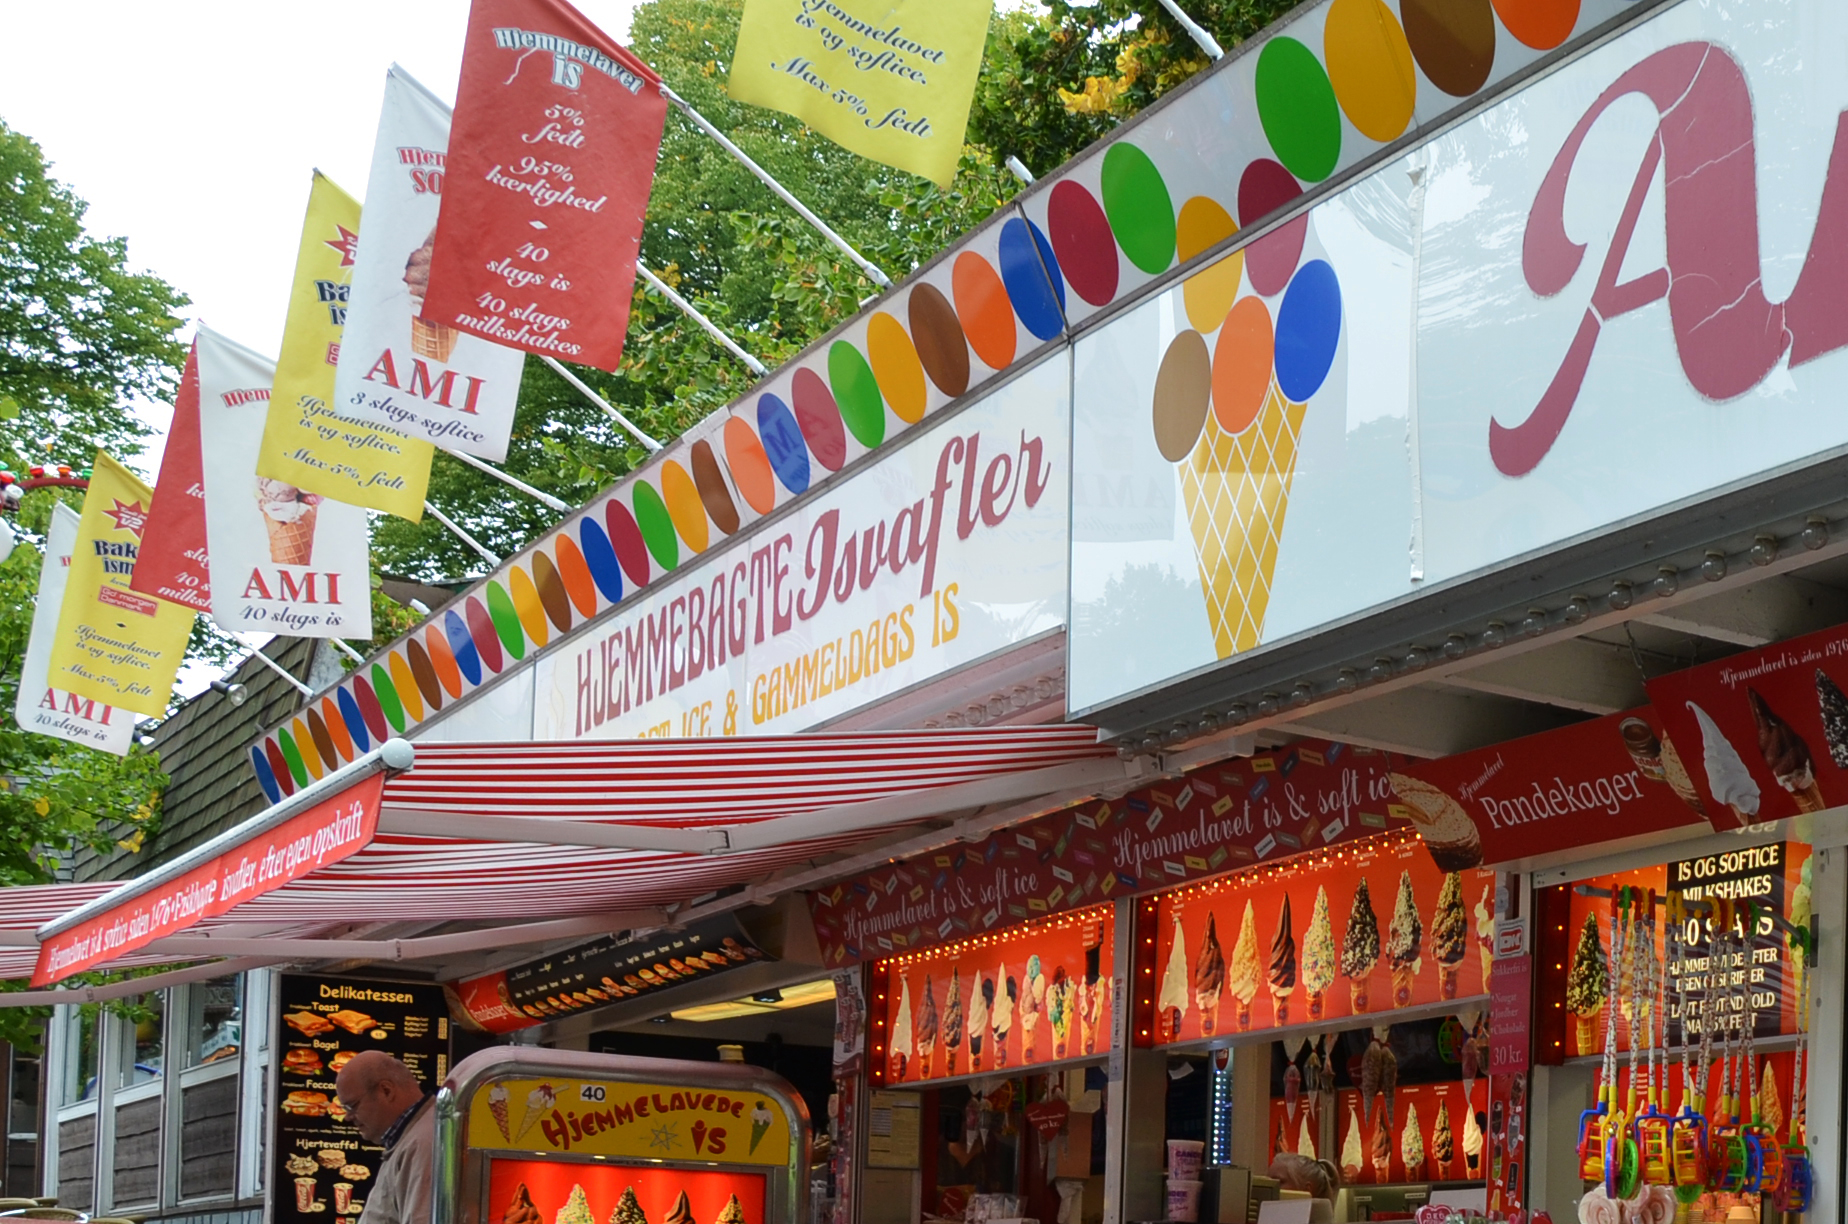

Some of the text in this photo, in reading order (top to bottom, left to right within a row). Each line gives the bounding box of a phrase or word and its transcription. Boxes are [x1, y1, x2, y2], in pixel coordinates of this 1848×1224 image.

[795, 10, 845, 51] is og
[493, 28, 645, 95] Hjemmelavet
[545, 104, 585, 126] 5%
[770, 57, 932, 138] Max 5% fedt
[521, 122, 586, 149] fedt
[509, 156, 574, 182] 95%
[485, 165, 608, 213] kærlighed
[516, 242, 549, 262] 40
[486, 257, 572, 291] slags is
[476, 292, 572, 333] 40 slags
[455, 313, 583, 355] milkshakes
[362, 348, 487, 415] AMI
[350, 392, 485, 443] 3 slags softice
[283, 446, 407, 491] Max 5% fedt
[240, 566, 343, 606] AMI
[575, 428, 1052, 738] HJEMMEBAGTE Isvafler
[239, 604, 343, 631] 40 slags is
[751, 581, 960, 726] GAMMELDAGS IS
[1800, 649, 1822, 666] siden
[38, 687, 113, 726] AMI
[52, 717, 91, 736] slags
[1478, 769, 1645, 829] Pandekager
[1111, 766, 1365, 880] Hjemmelavet is & soft
[1678, 845, 1780, 882] IS OG SOFTICE
[843, 866, 1039, 952] Hjemmelavet is soft ice
[311, 1002, 340, 1012] Toast
[319, 983, 414, 1004] Delikatessen
[313, 1039, 340, 1051] Bagel
[1493, 1044, 1523, 1066] 30 kr.
[581, 1085, 606, 1101] 40
[295, 1138, 359, 1151] Hjertevaffel
